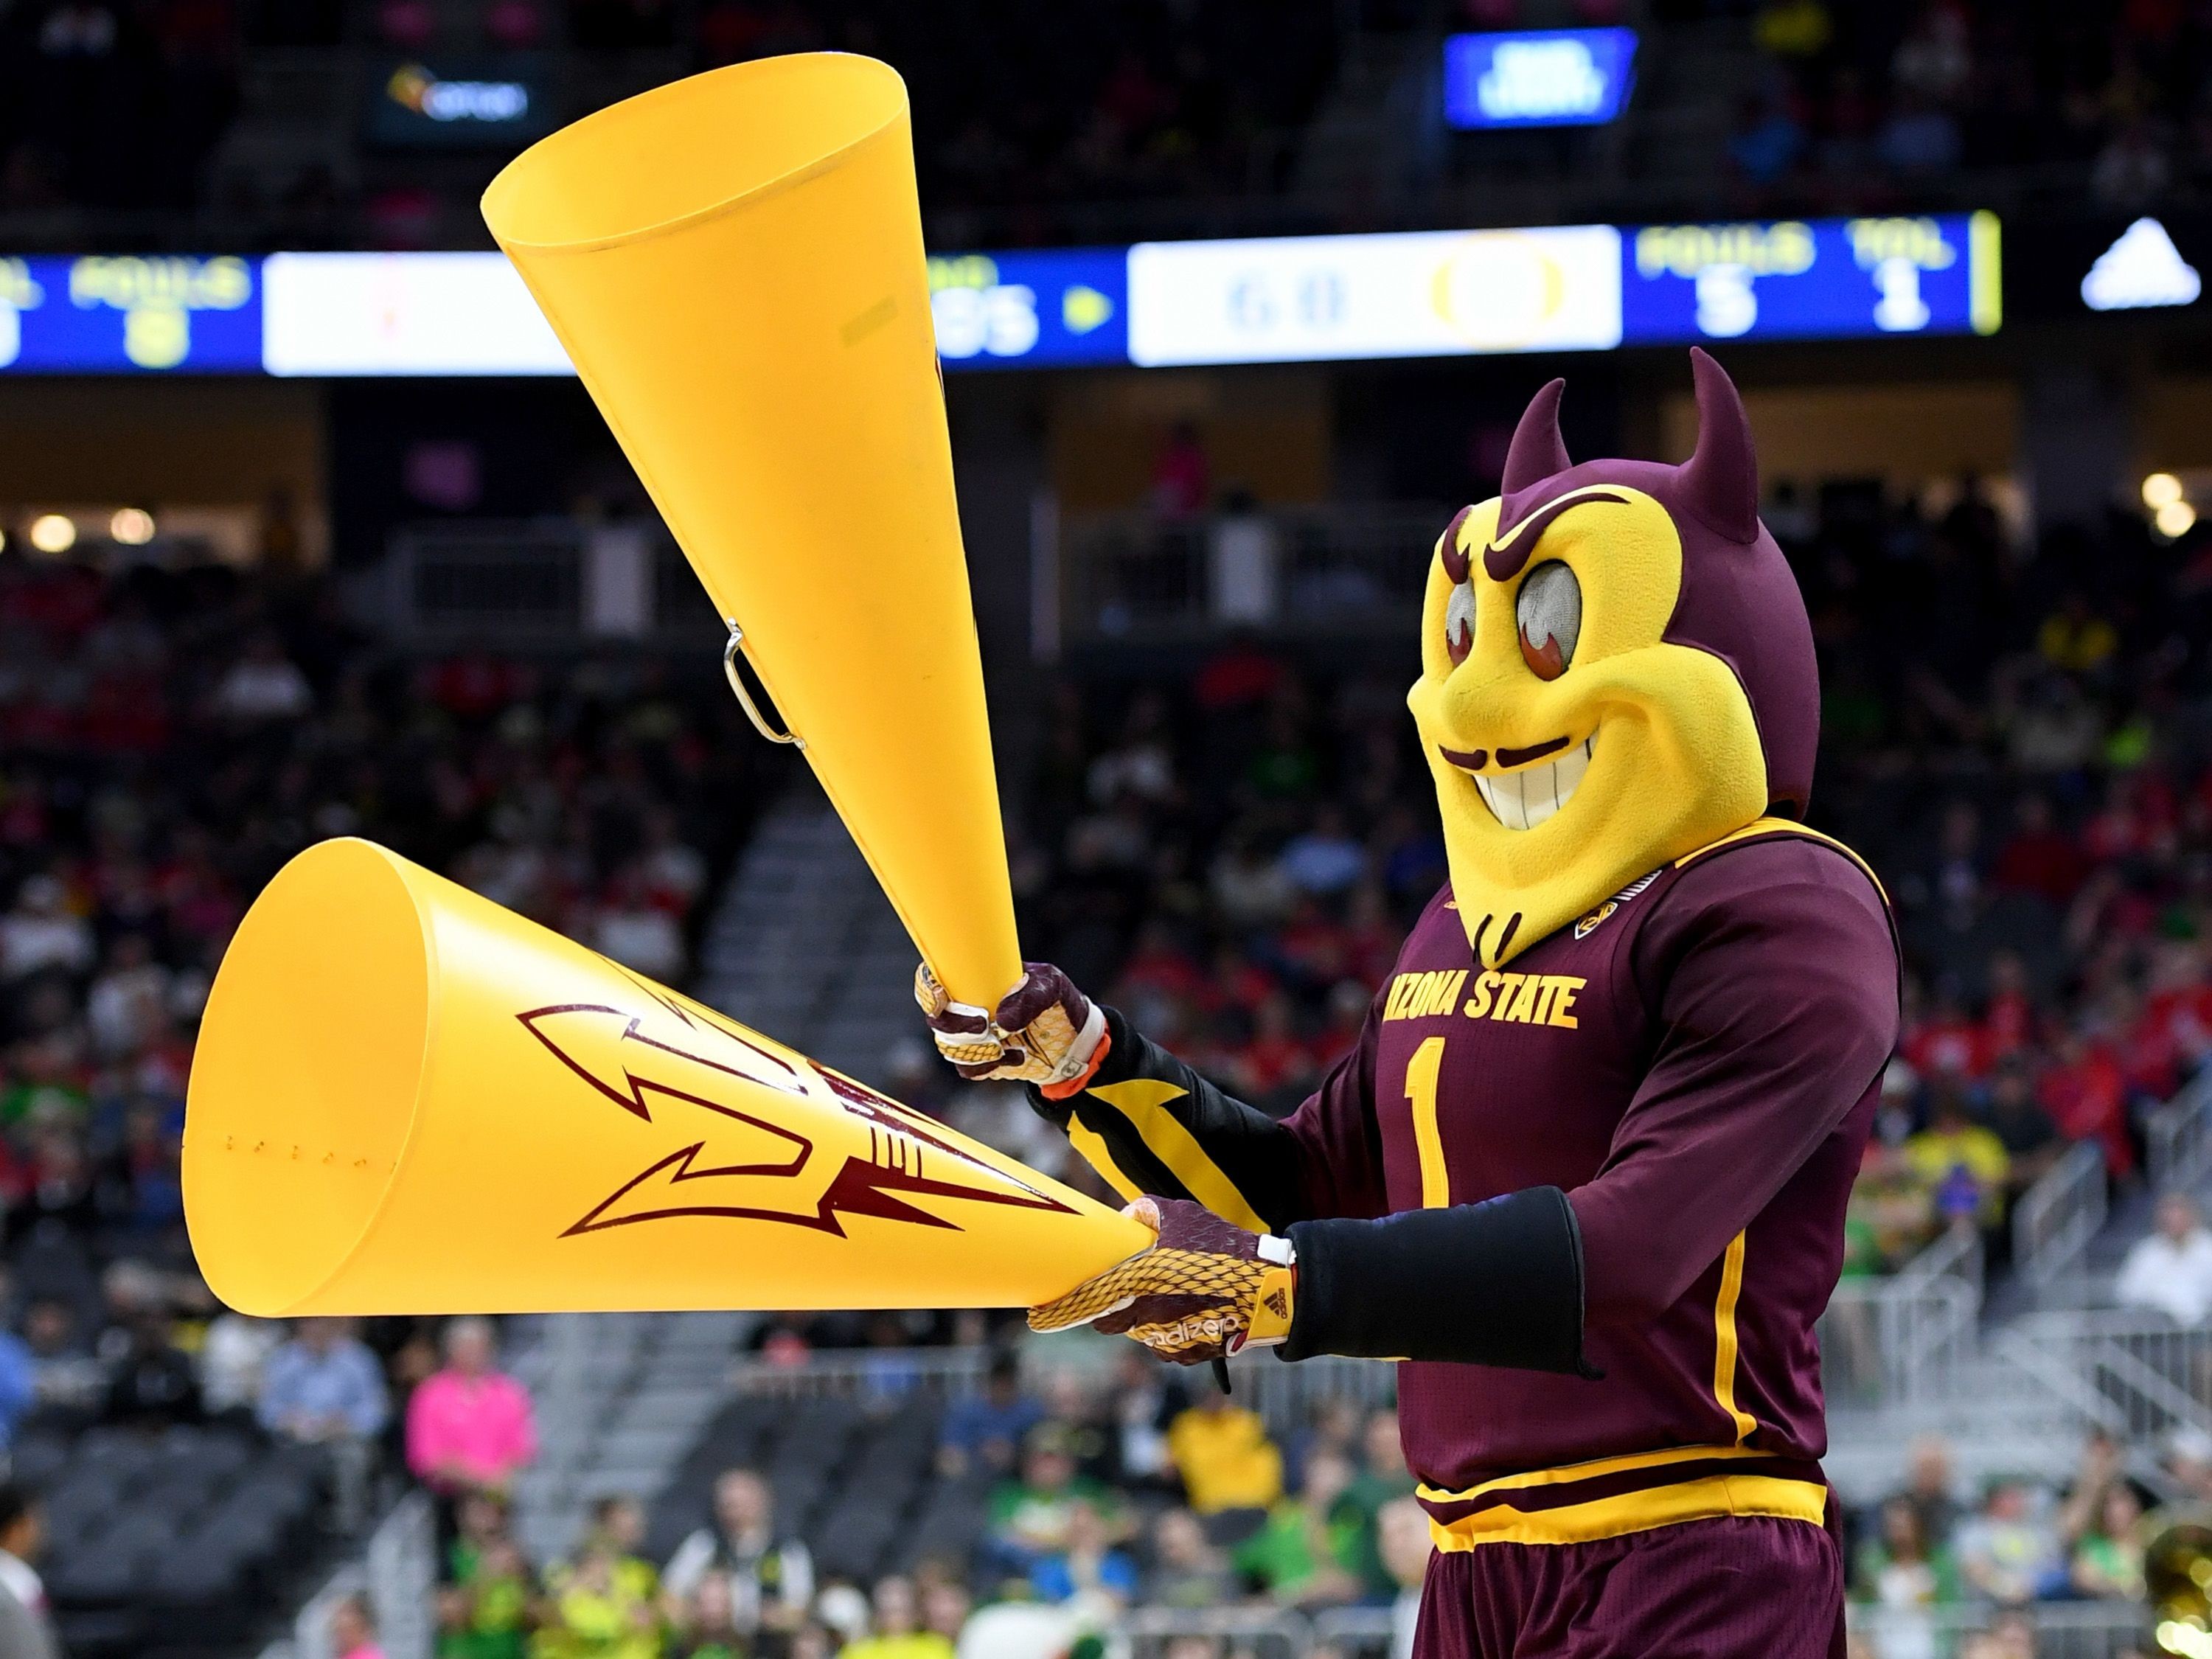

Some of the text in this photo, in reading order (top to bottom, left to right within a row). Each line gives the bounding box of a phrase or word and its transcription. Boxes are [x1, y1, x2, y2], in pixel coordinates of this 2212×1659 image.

[1635, 221, 1815, 280] FOULS
[69, 256, 252, 310] FOULS
[1464, 970, 1587, 1029] STATE
[1405, 1037, 1450, 1208] 1
